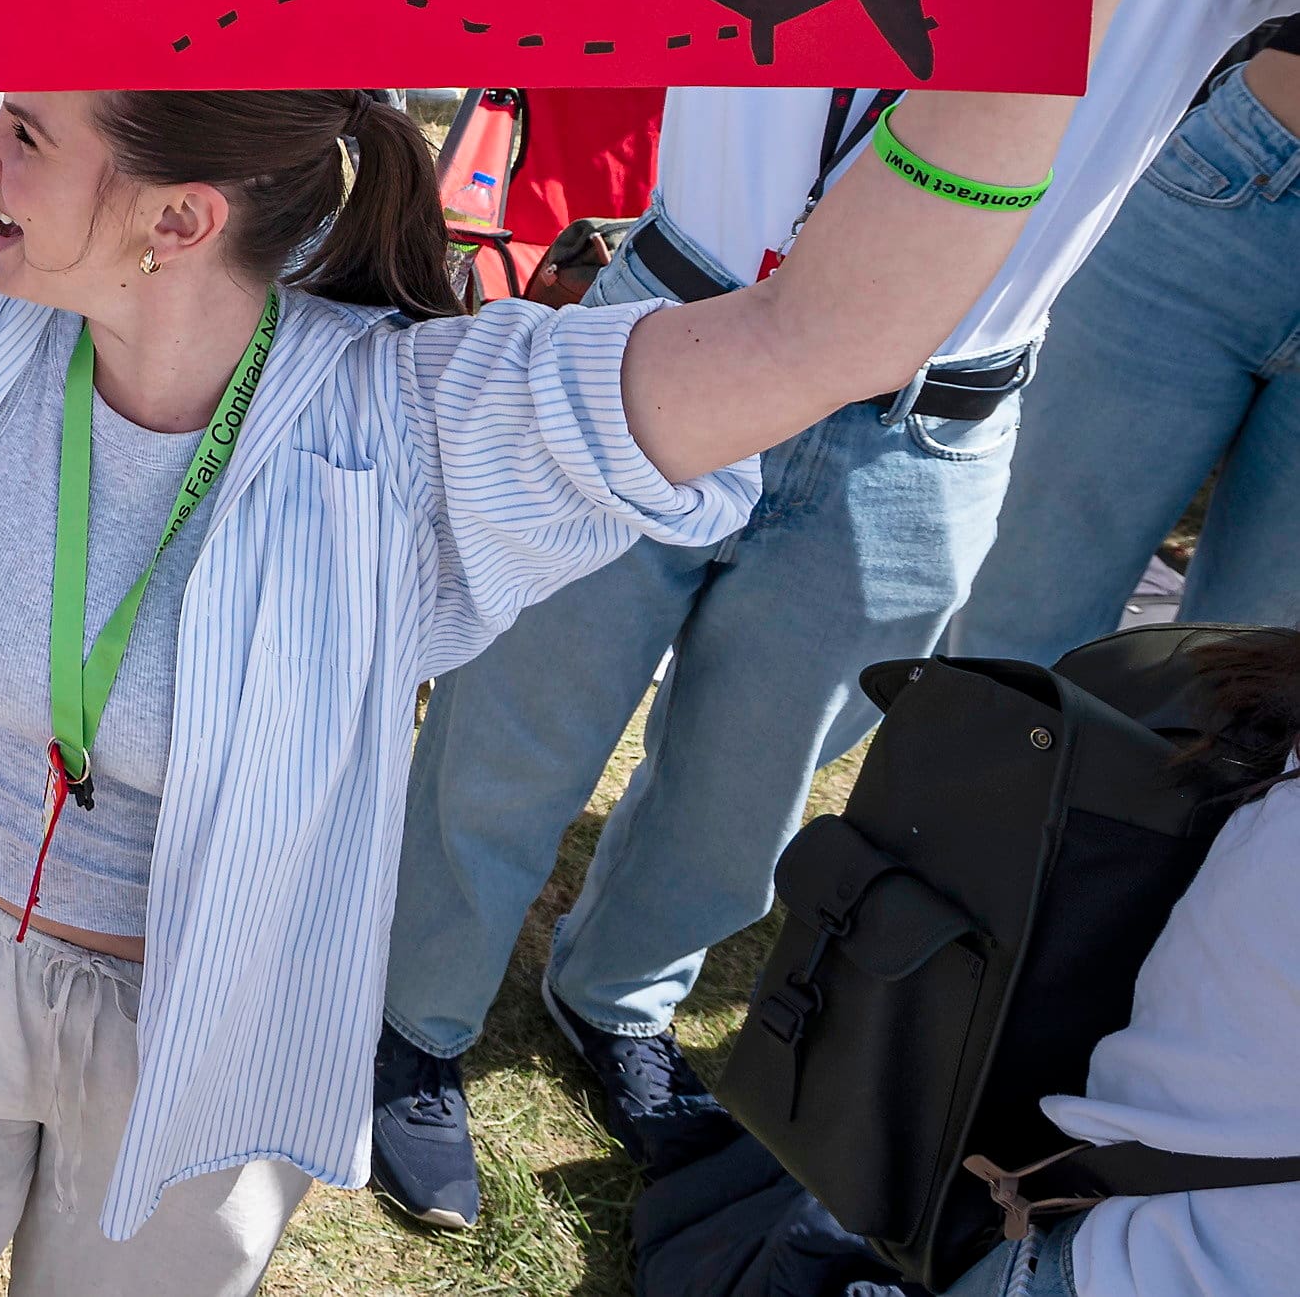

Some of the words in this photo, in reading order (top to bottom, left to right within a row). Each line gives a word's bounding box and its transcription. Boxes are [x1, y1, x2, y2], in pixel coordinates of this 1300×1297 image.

[885, 150, 930, 186] Now!
[932, 179, 1031, 208] Contract
[185, 449, 222, 499] Fair
[211, 341, 269, 446] Contract
